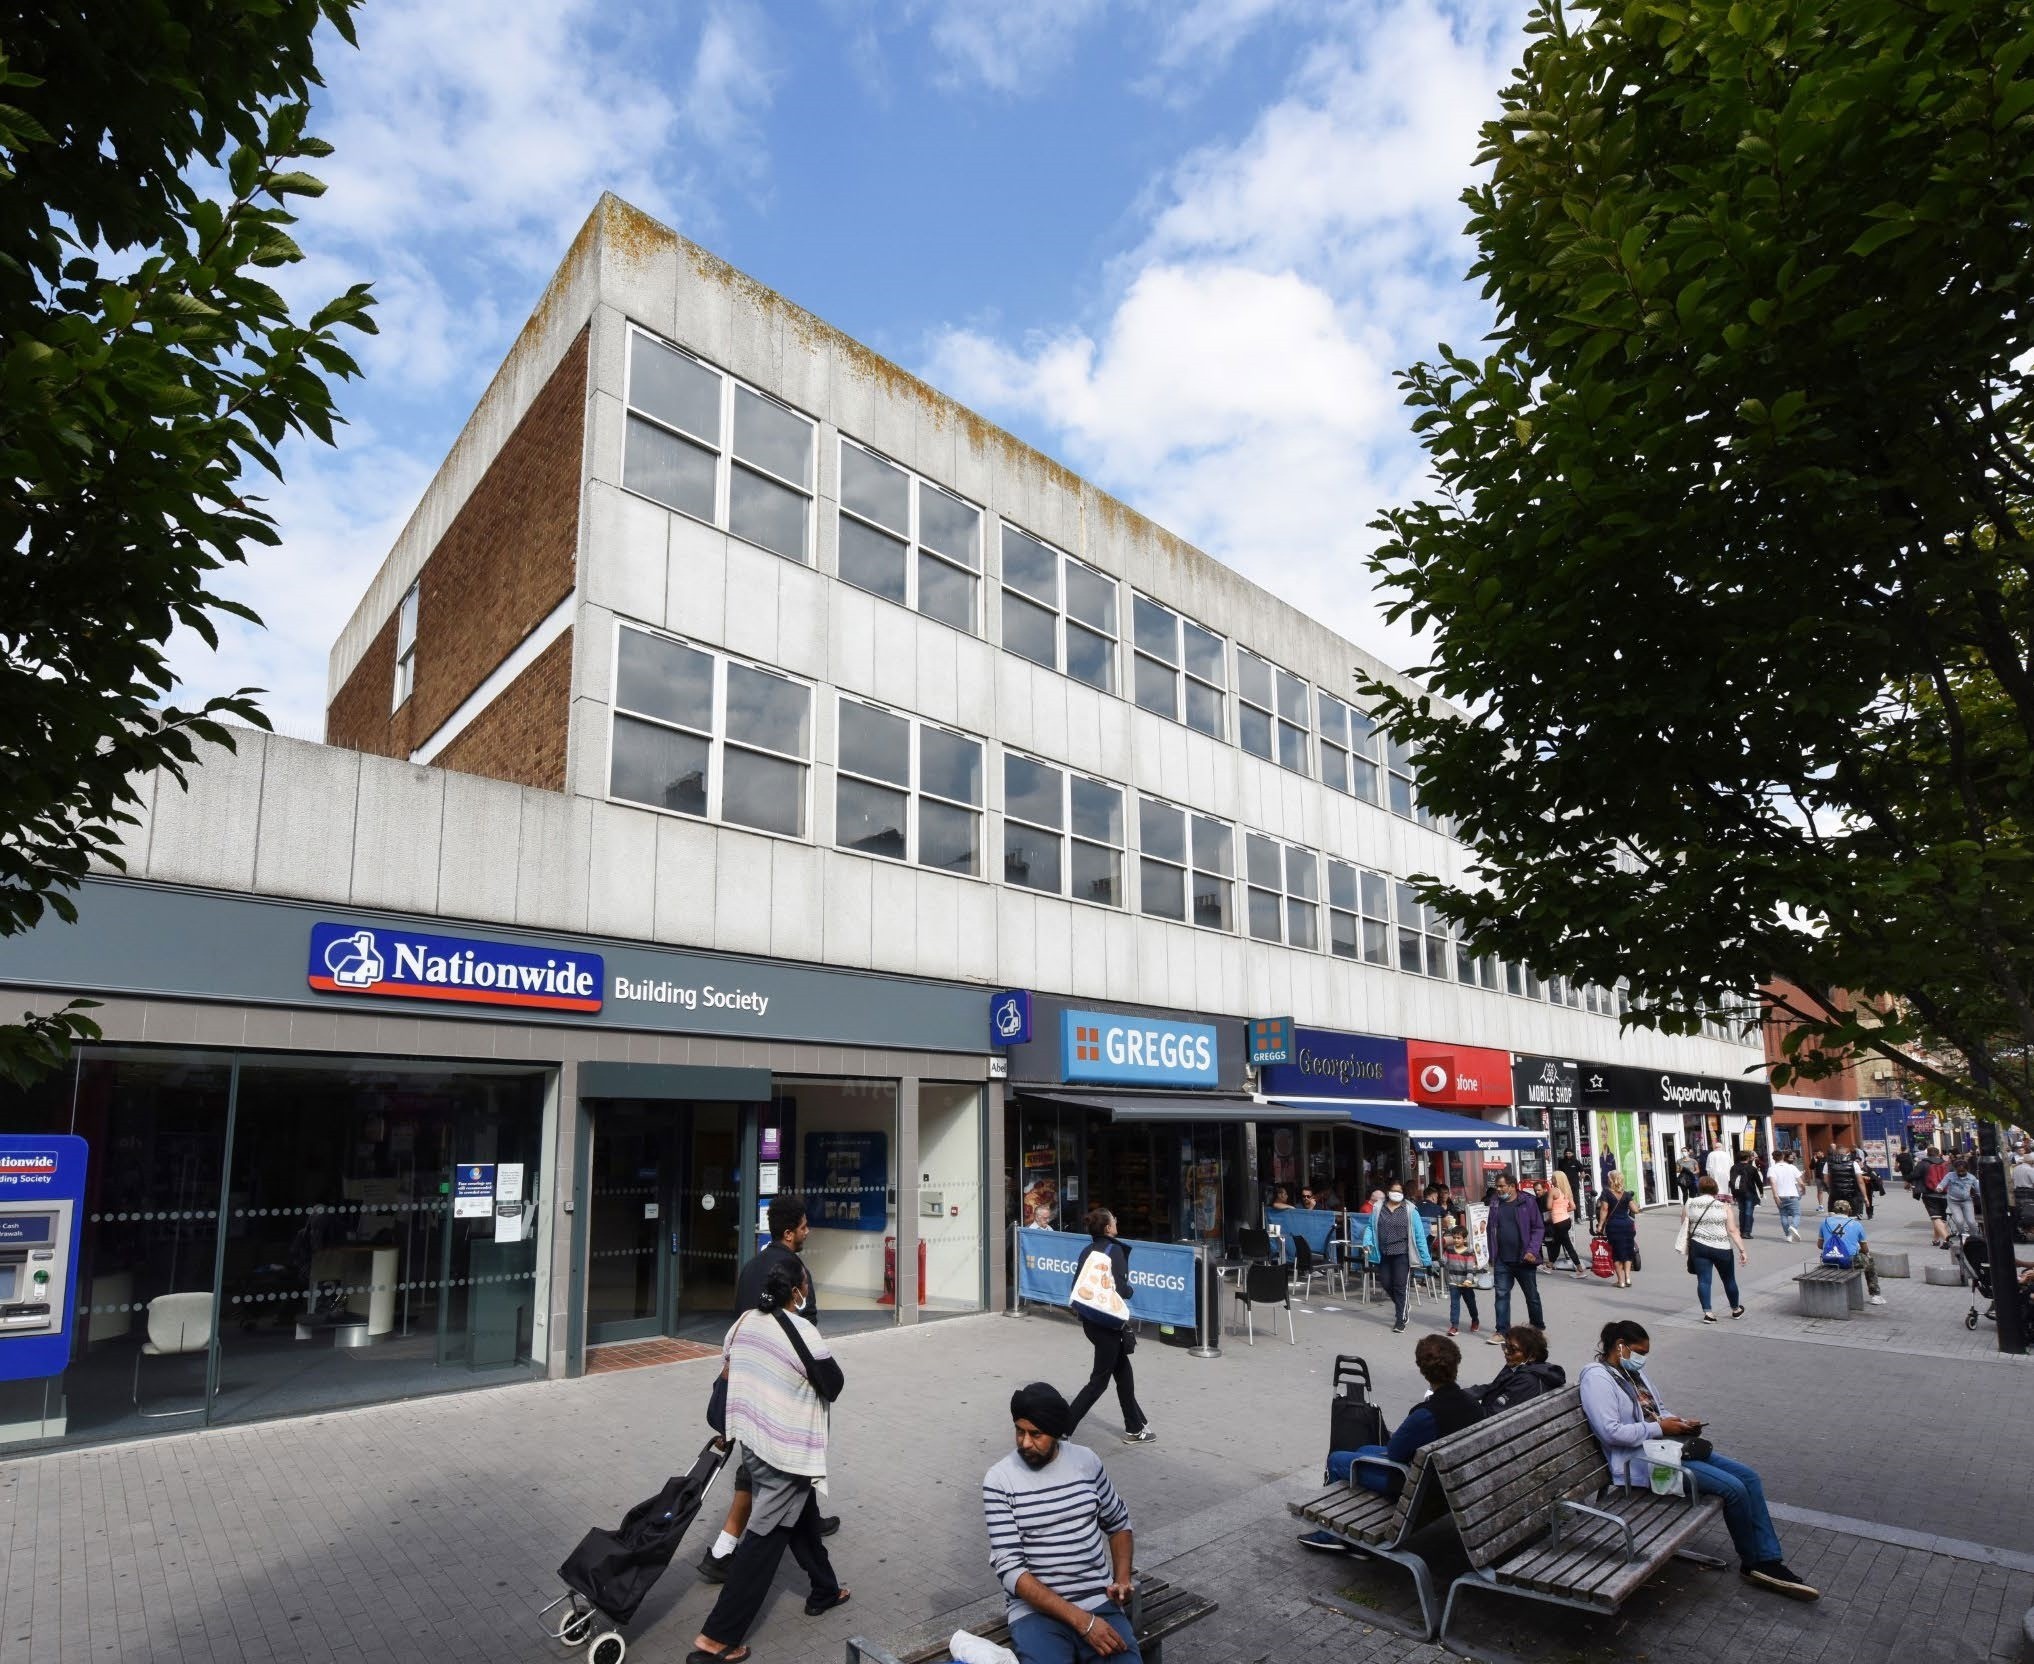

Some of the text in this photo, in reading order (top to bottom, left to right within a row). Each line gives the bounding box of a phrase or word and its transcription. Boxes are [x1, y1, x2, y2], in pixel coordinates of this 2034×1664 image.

[392, 943, 593, 996] Nationwide
[615, 976, 769, 1016] Building Society
[1106, 1027, 1210, 1071] GREGGS
[1253, 1050, 1287, 1062] GREGGS
[1299, 1048, 1383, 1085] Georginos
[1528, 1084, 1572, 1104] MOBILE SHOP
[1661, 1075, 1721, 1111] Superdrug
[0, 1156, 53, 1167] tionwide
[20, 1174, 52, 1183] Society
[1037, 1257, 1078, 1275] GREGG
[1128, 1270, 1185, 1292] GREGGS
